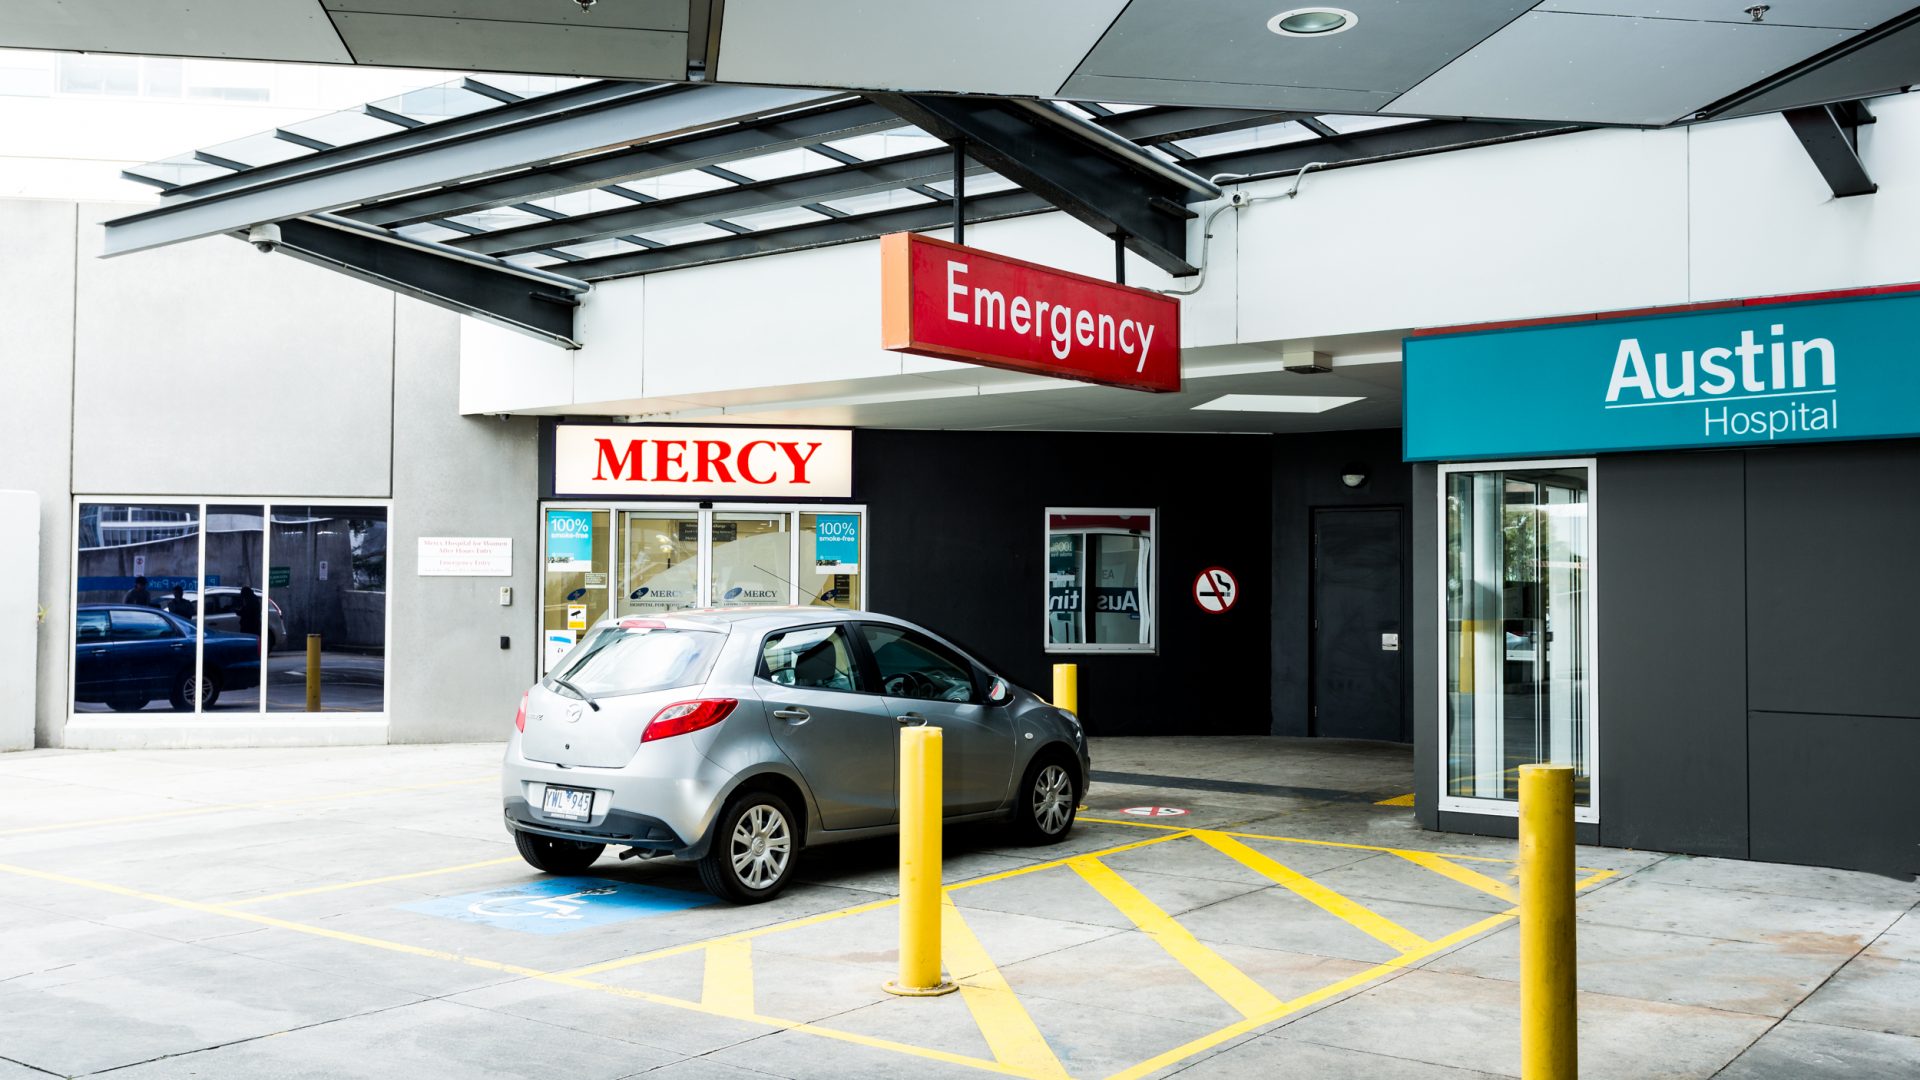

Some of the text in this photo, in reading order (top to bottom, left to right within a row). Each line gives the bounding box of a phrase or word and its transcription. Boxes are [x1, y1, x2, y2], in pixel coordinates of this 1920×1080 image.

[947, 260, 1155, 373] Emergency
[1605, 323, 1837, 402] Austin
[1705, 400, 1838, 439] Hospital
[592, 438, 823, 485] MERCY
[551, 518, 589, 532] 100%
[819, 522, 855, 535] 100%
[445, 540, 471, 548] Hospital
[744, 590, 778, 598] MERCY
[571, 794, 590, 811] 945
